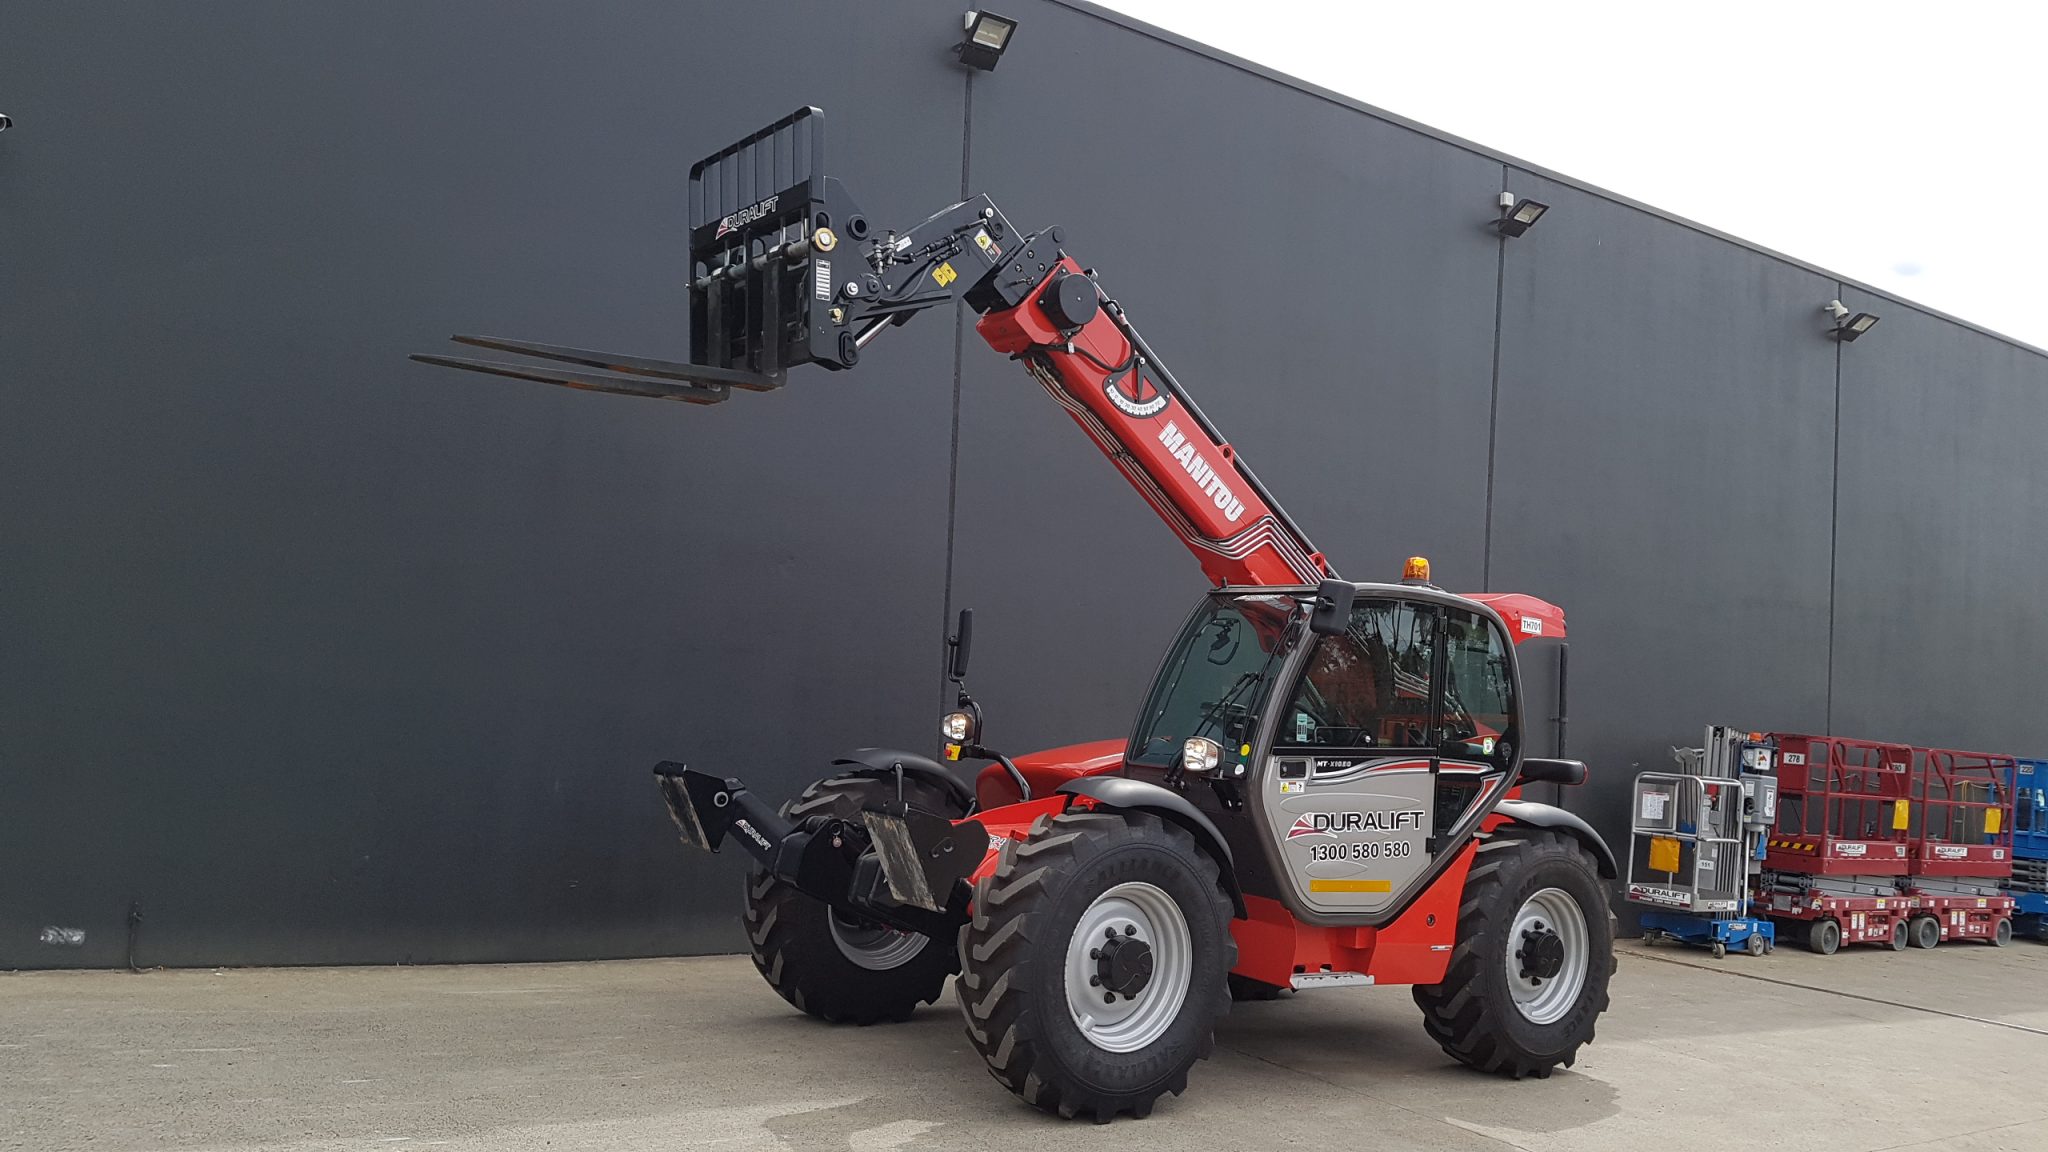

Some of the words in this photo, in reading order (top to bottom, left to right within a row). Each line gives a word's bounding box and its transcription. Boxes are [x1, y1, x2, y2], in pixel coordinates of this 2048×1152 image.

[727, 195, 779, 228] DURALIFT
[1158, 420, 1246, 522] MANITOU
[1523, 620, 1541, 631] TH701
[1788, 754, 1801, 763] 278
[1313, 811, 1424, 832] DURALIFT
[1311, 844, 1348, 861] 1300
[1352, 843, 1380, 859] 580
[1384, 841, 1410, 858] 580
[1640, 887, 1687, 900] DURALIFT
